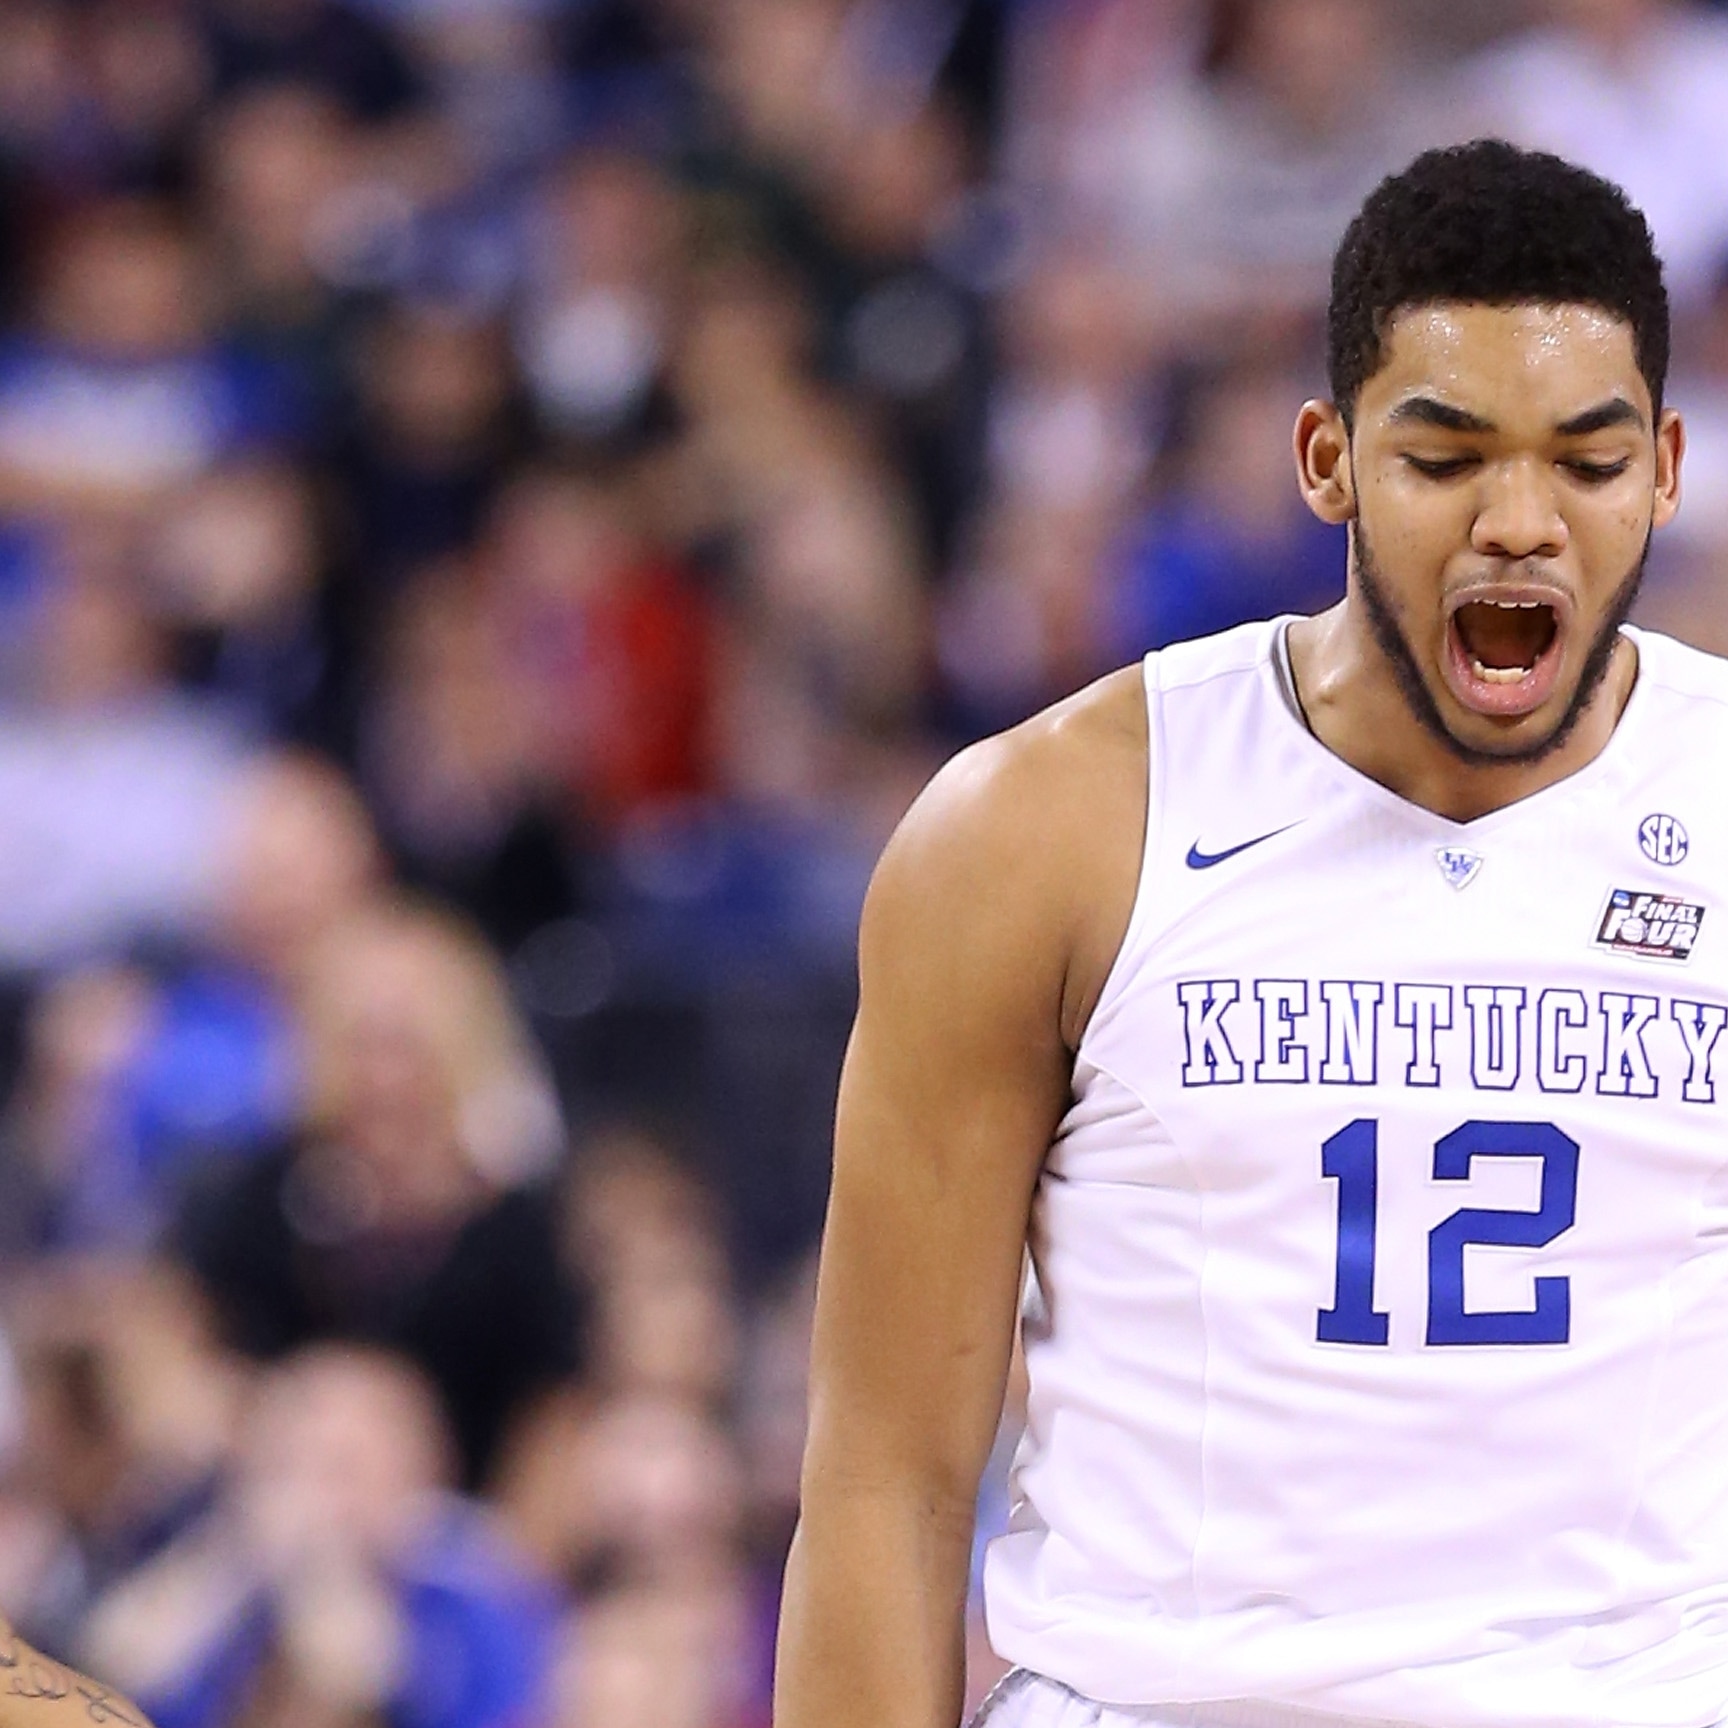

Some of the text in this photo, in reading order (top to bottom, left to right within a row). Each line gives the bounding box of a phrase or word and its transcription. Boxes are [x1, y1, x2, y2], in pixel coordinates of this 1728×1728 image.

[1638, 813, 1689, 866] SEC
[1632, 895, 1698, 923] FINAL
[1177, 979, 1728, 1103] KENTUCKY
[1315, 1117, 1581, 1346] 12
